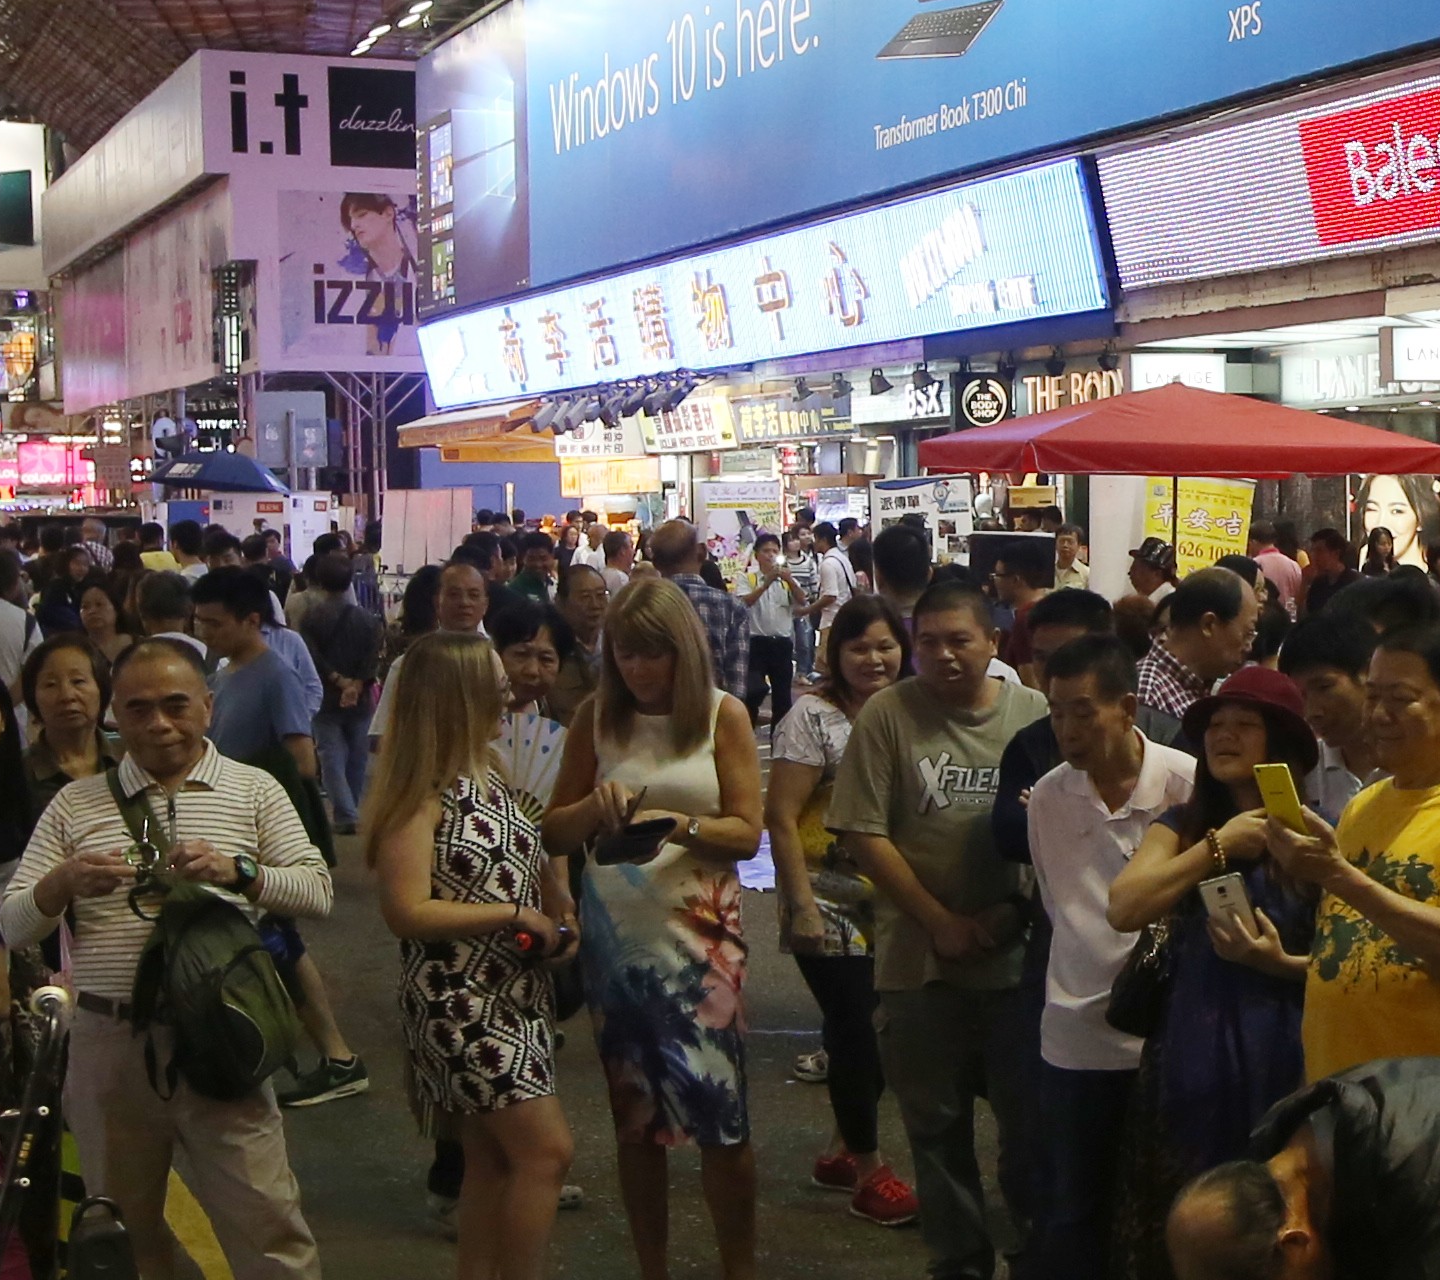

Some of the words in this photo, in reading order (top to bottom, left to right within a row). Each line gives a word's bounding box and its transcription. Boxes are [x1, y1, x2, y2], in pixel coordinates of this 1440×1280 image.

[1228, 0, 1262, 42] XPS
[549, 52, 660, 156] Windows
[667, 12, 698, 103] 10
[704, 7, 728, 88] is
[874, 108, 937, 151] Transformer
[940, 100, 971, 130] Book
[972, 87, 1002, 123] T300
[1004, 77, 1027, 111] Chi
[971, 400, 998, 409] BODY
[973, 408, 998, 418] SHOP
[976, 393, 991, 401] THE
[1023, 375, 1067, 415] THE
